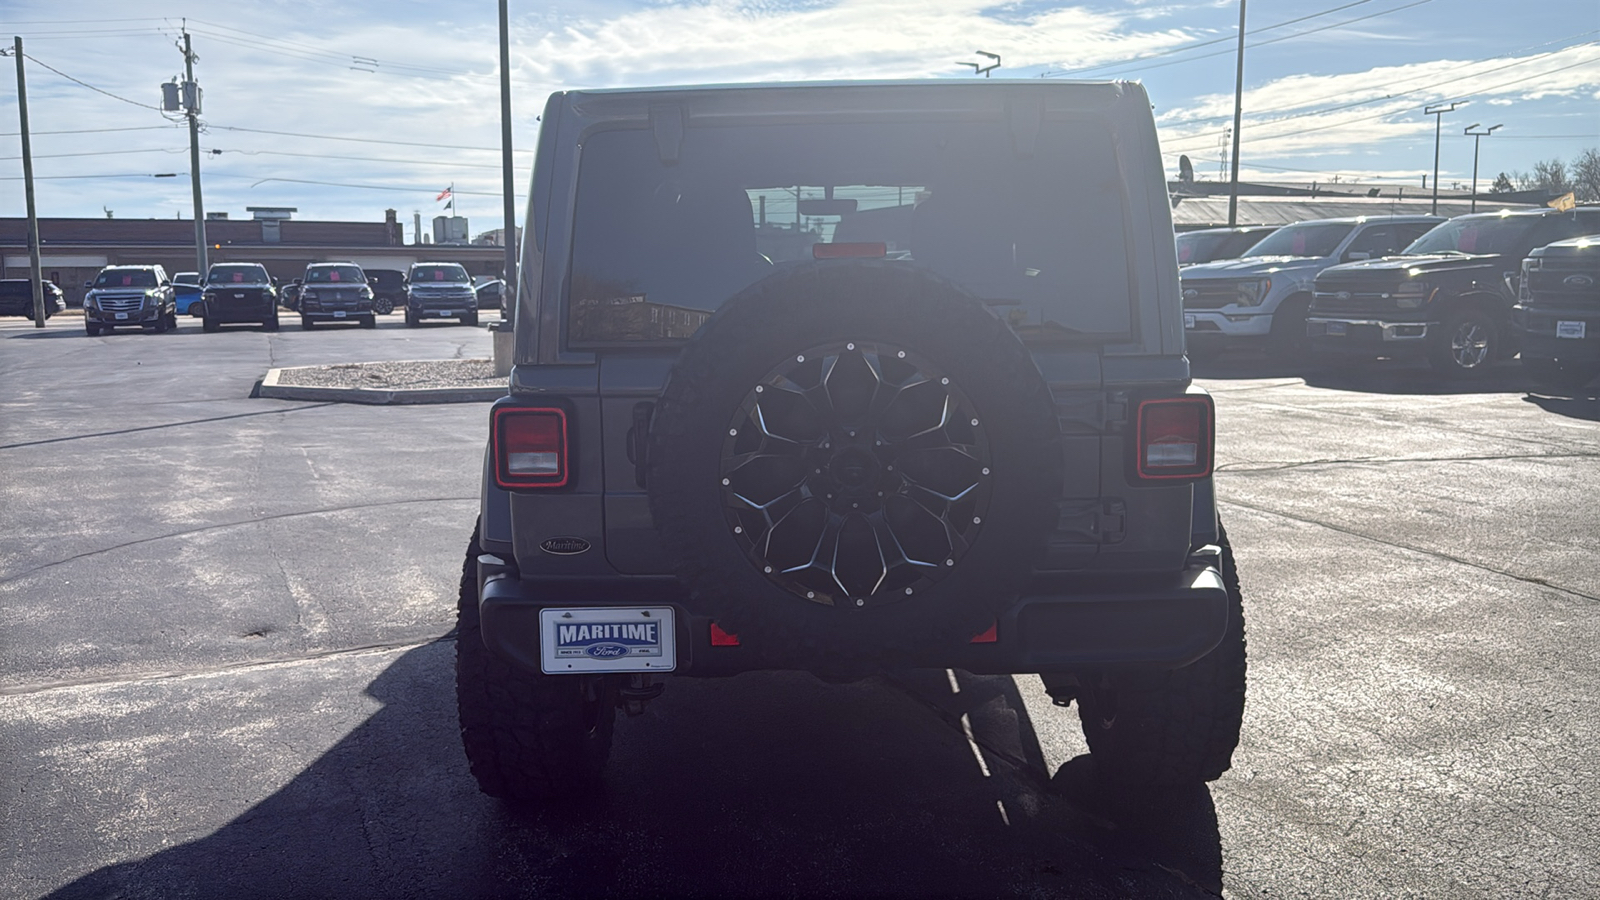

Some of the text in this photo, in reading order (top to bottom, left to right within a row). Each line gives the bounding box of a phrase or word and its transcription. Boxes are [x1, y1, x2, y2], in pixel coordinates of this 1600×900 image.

[545, 540, 586, 550] Maritime
[559, 623, 656, 645] MARITIME
[593, 646, 621, 656] Ford
